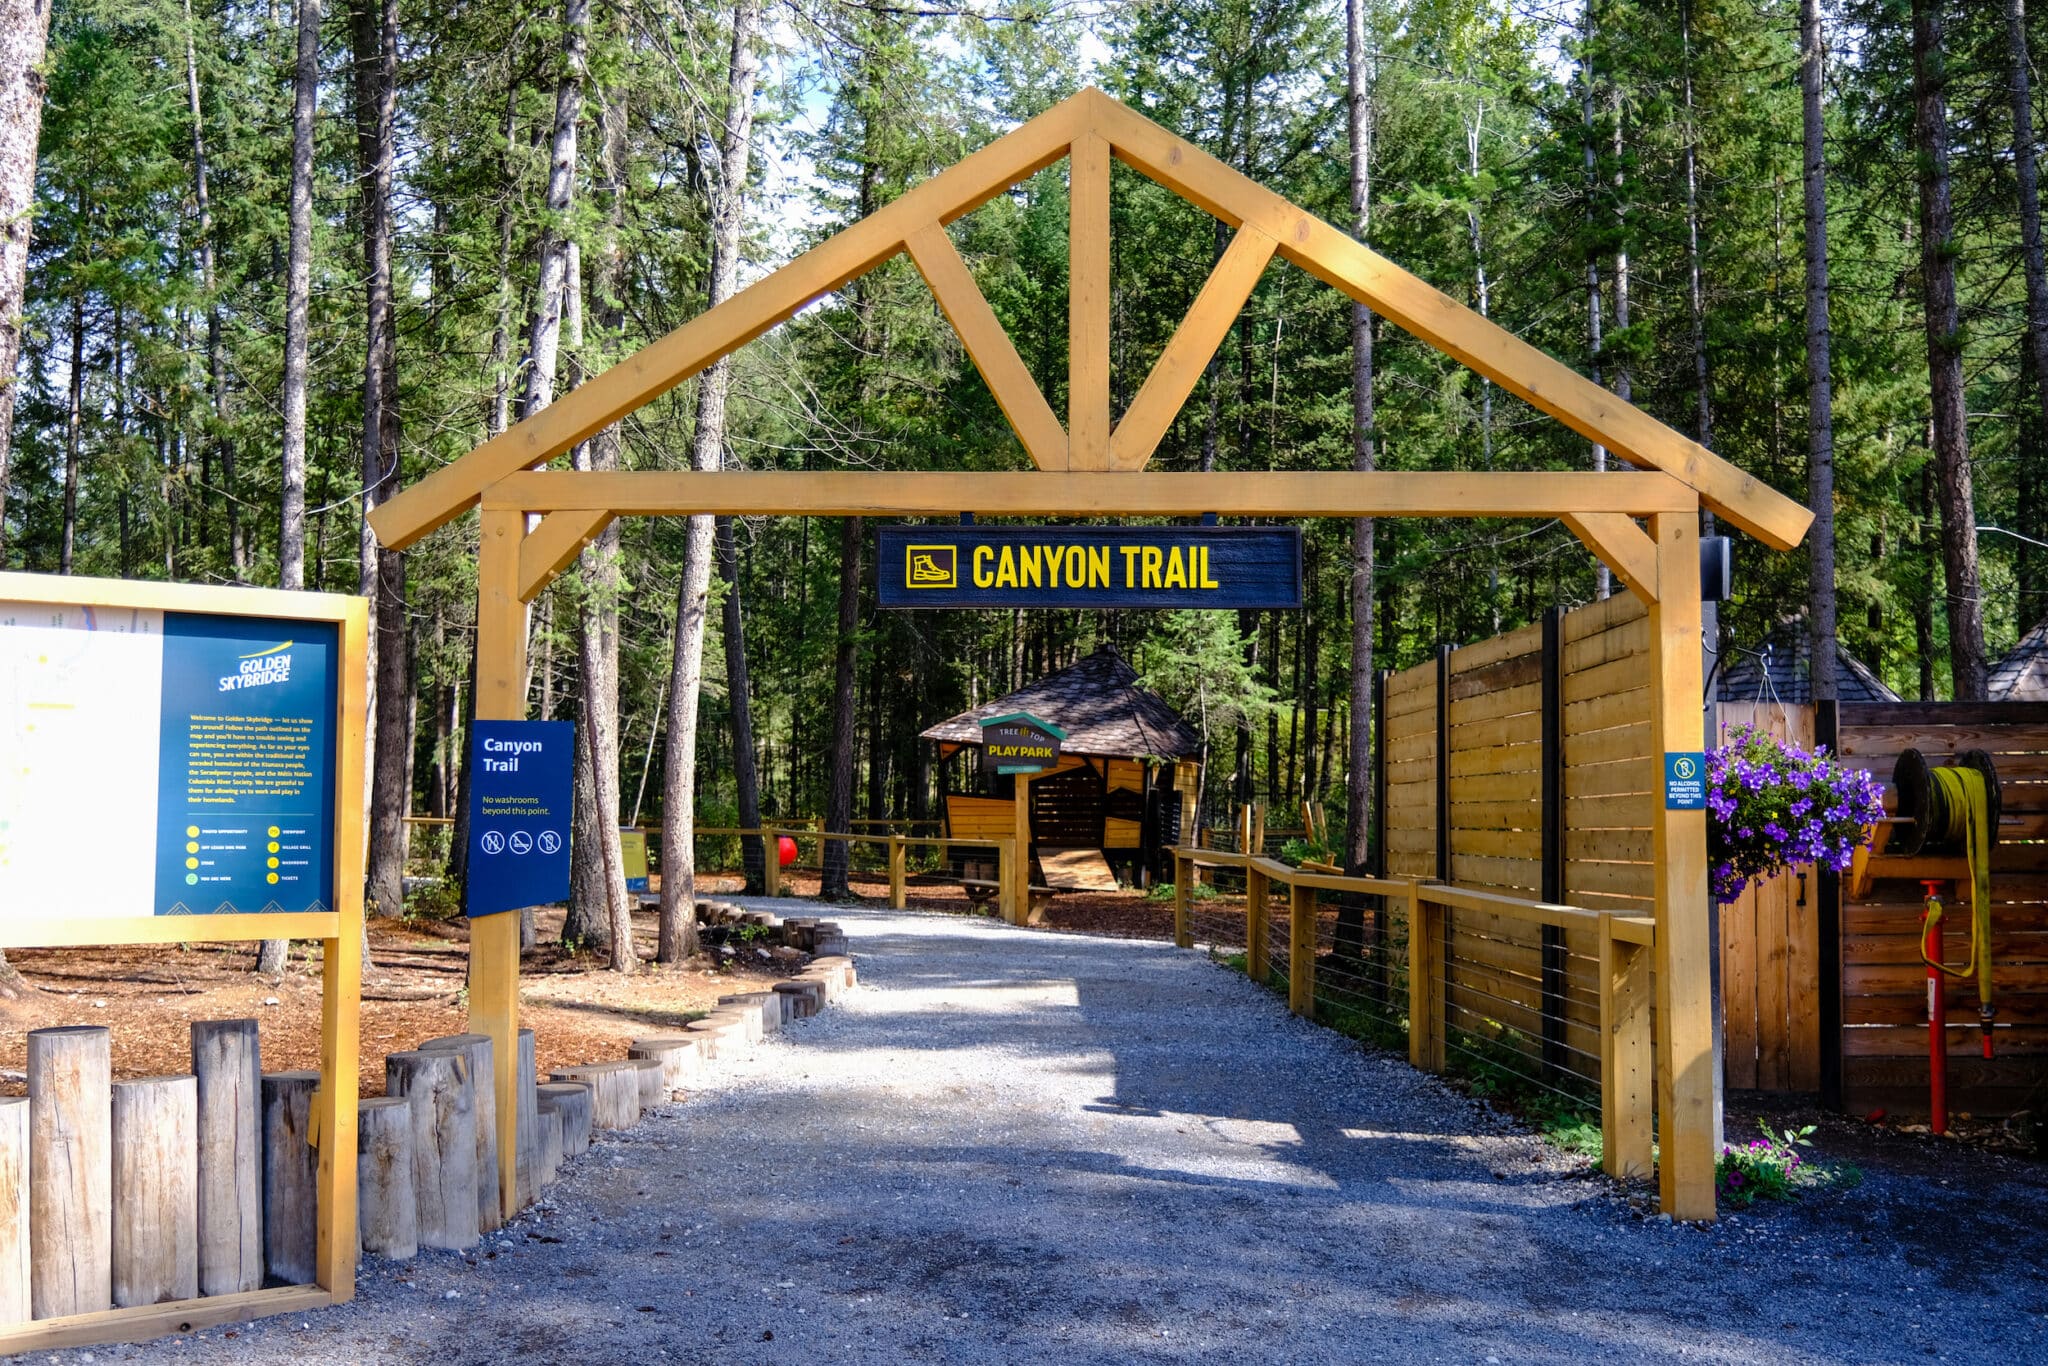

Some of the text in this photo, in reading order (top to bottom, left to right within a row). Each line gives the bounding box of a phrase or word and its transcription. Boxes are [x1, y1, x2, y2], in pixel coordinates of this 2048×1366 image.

[973, 545, 1219, 589] CANYON TRAIL
[240, 655, 291, 673] GOLDEN
[219, 668, 290, 691] SKYBRIDGE
[1030, 732, 1045, 741] TOP
[484, 738, 542, 755] Canyon
[989, 745, 1052, 757] PLAY PARK
[483, 758, 518, 771] Trail
[482, 807, 510, 816] beyond
[528, 807, 550, 816] point.
